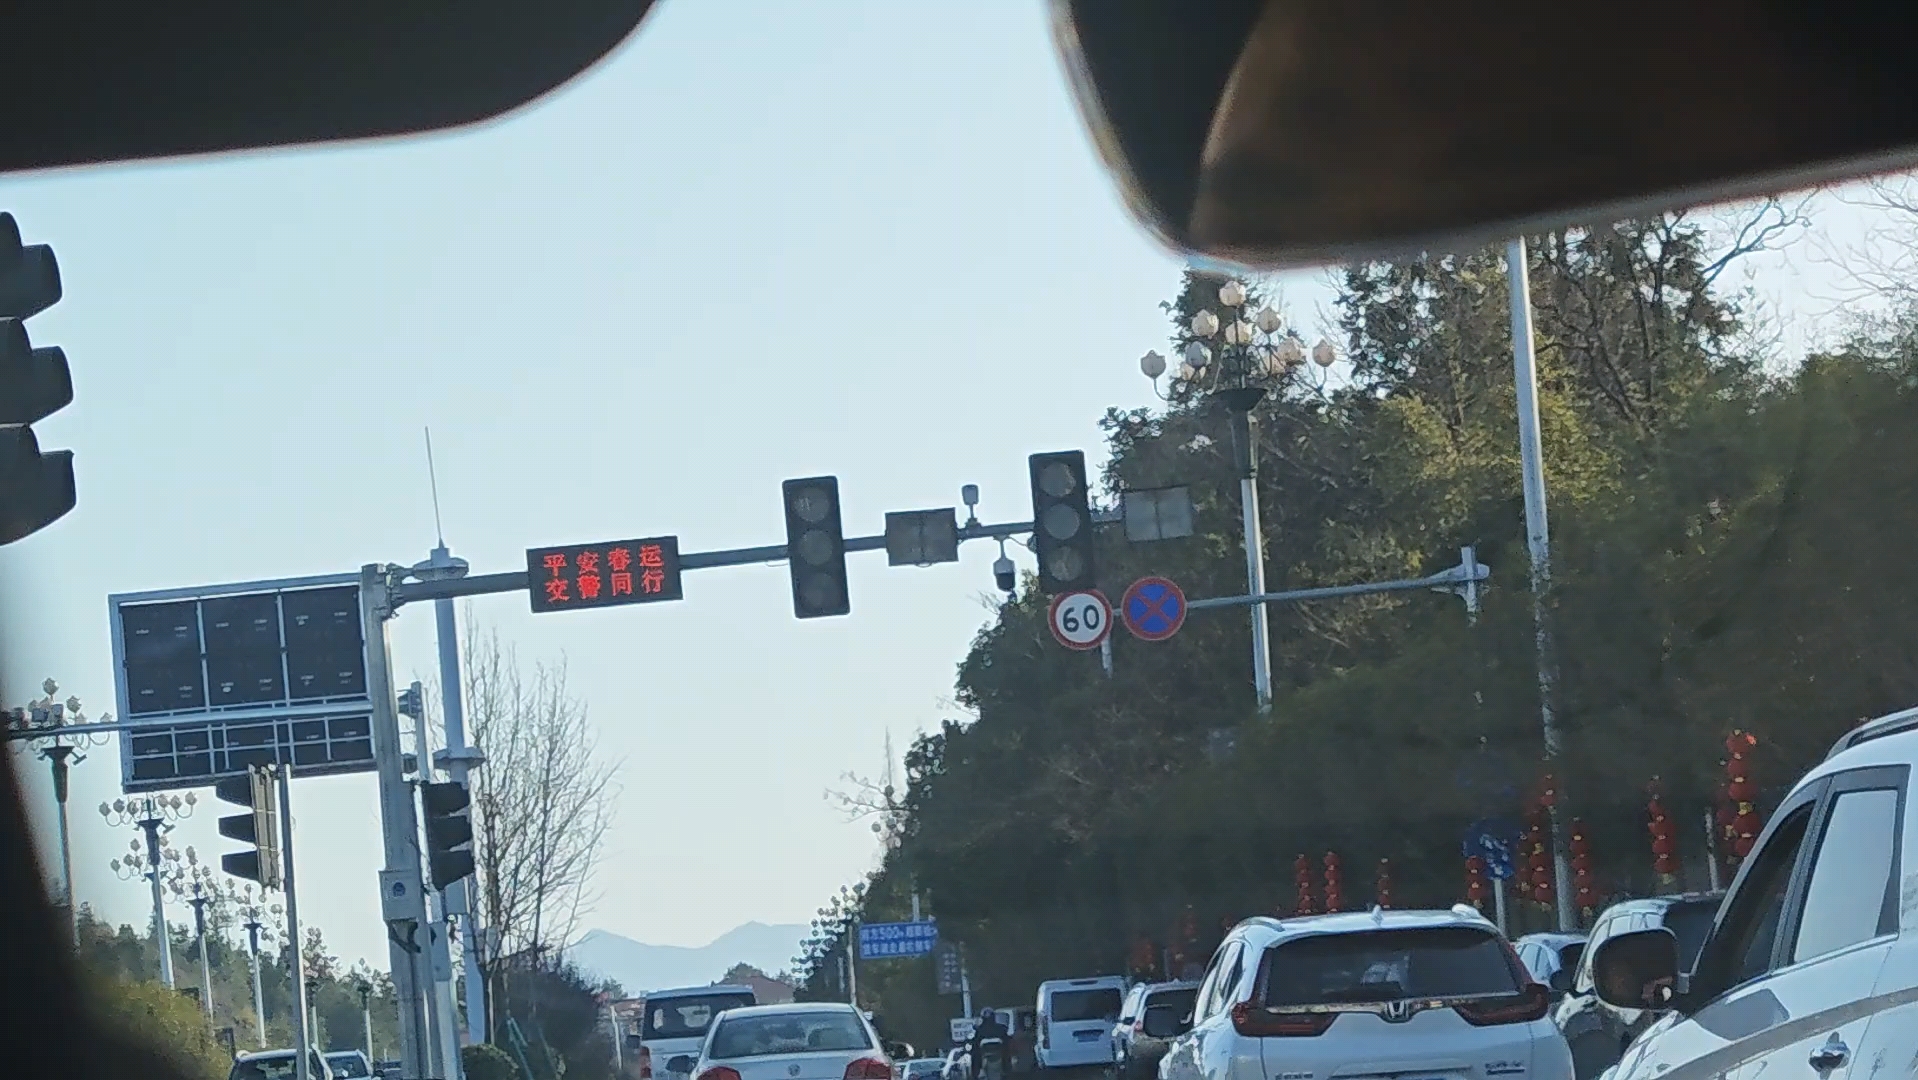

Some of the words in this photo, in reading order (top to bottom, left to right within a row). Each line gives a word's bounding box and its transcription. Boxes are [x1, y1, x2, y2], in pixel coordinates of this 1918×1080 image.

[543, 545, 664, 577] 平安春运
[545, 570, 665, 602] 交警同行
[1063, 604, 1100, 632] 60
